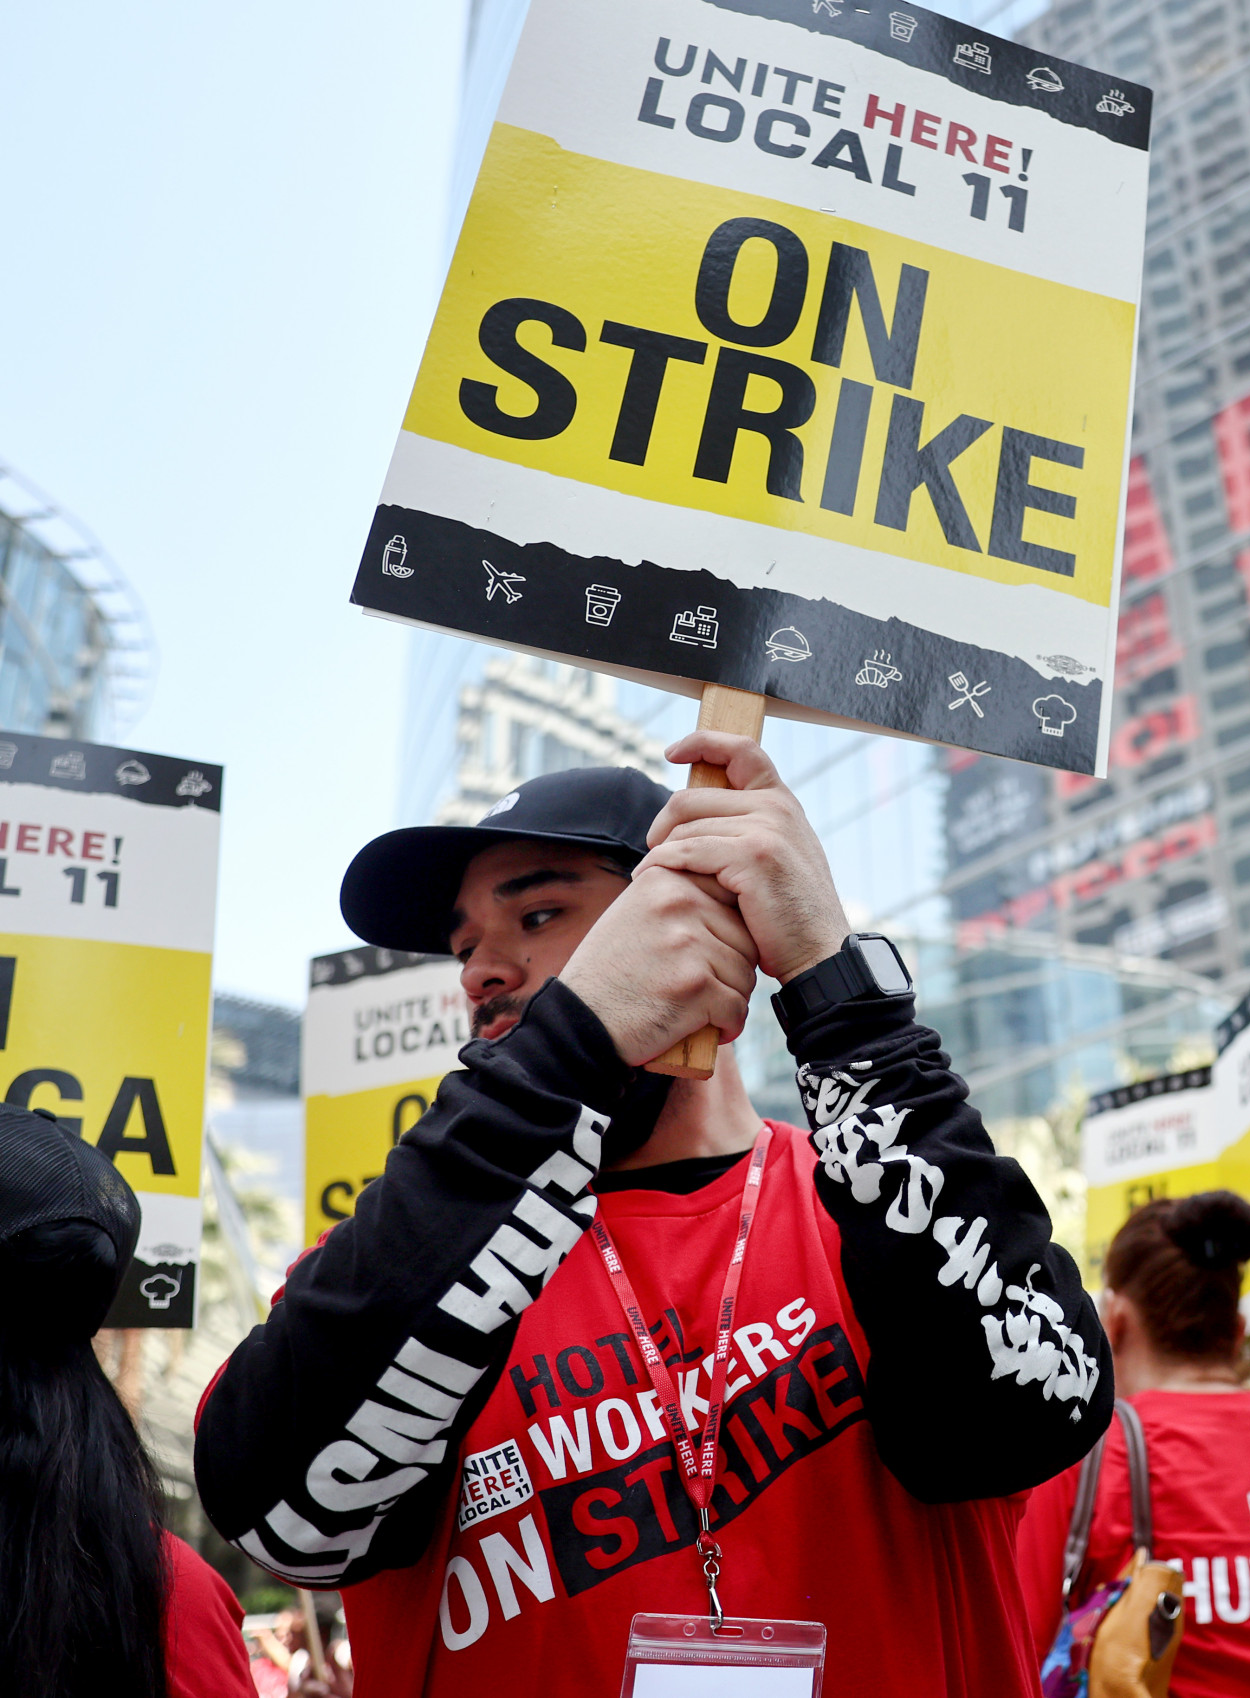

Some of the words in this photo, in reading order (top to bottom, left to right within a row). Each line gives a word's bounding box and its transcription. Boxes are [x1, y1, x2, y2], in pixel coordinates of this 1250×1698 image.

[637, 77, 917, 198] LOCAL
[961, 172, 1030, 233] 11
[653, 36, 847, 120] UNITE
[863, 93, 1034, 182] HERE!
[694, 216, 929, 391] ON
[458, 297, 1086, 579] STRIKE
[62, 867, 121, 909] 11
[355, 993, 434, 1031] UNITE
[355, 1018, 467, 1062] LOCAL
[441, 1512, 556, 1652] ON
[571, 1337, 864, 1570] STRIKE
[459, 1494, 511, 1527] LOCAL
[515, 1483, 530, 1498] 11
[462, 1445, 519, 1483] NITE
